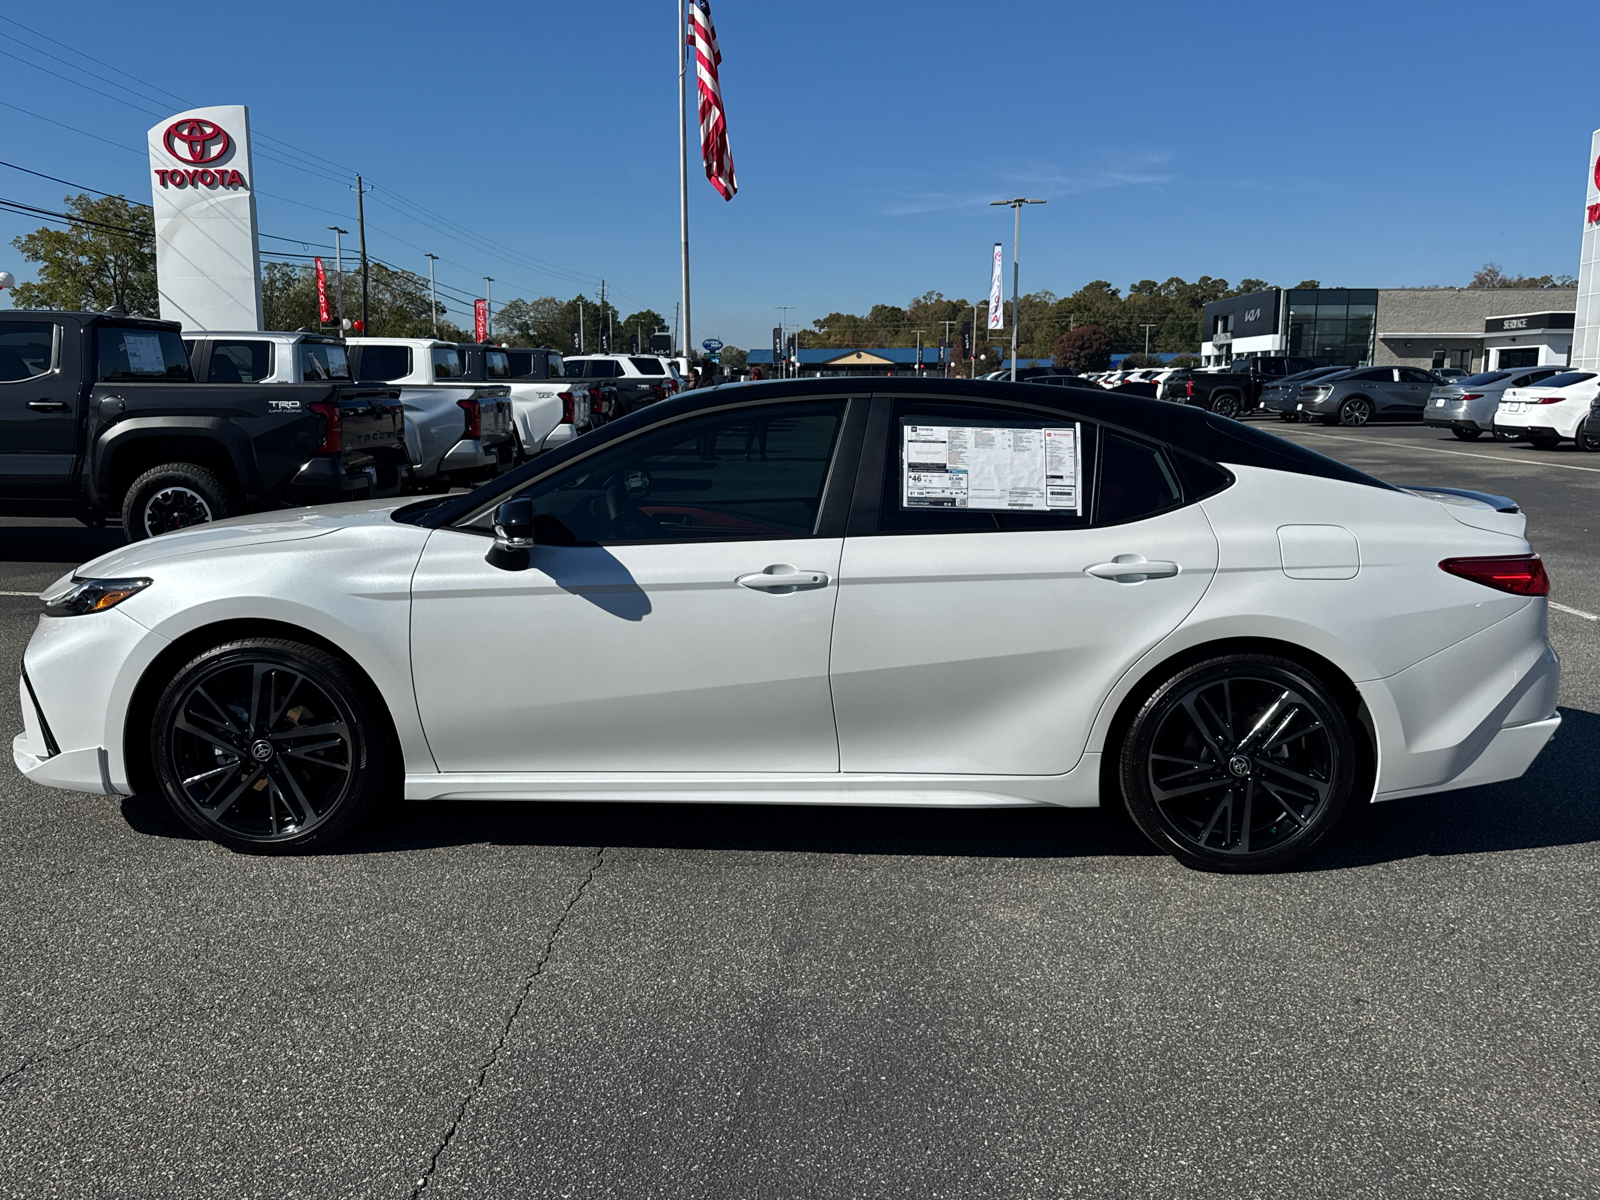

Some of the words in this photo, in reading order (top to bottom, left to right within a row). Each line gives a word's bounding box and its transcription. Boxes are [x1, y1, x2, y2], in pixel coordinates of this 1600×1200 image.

[154, 169, 243, 186] TOYOTA
[1244, 308, 1261, 322] KIA
[1503, 318, 1528, 330] SERVICE
